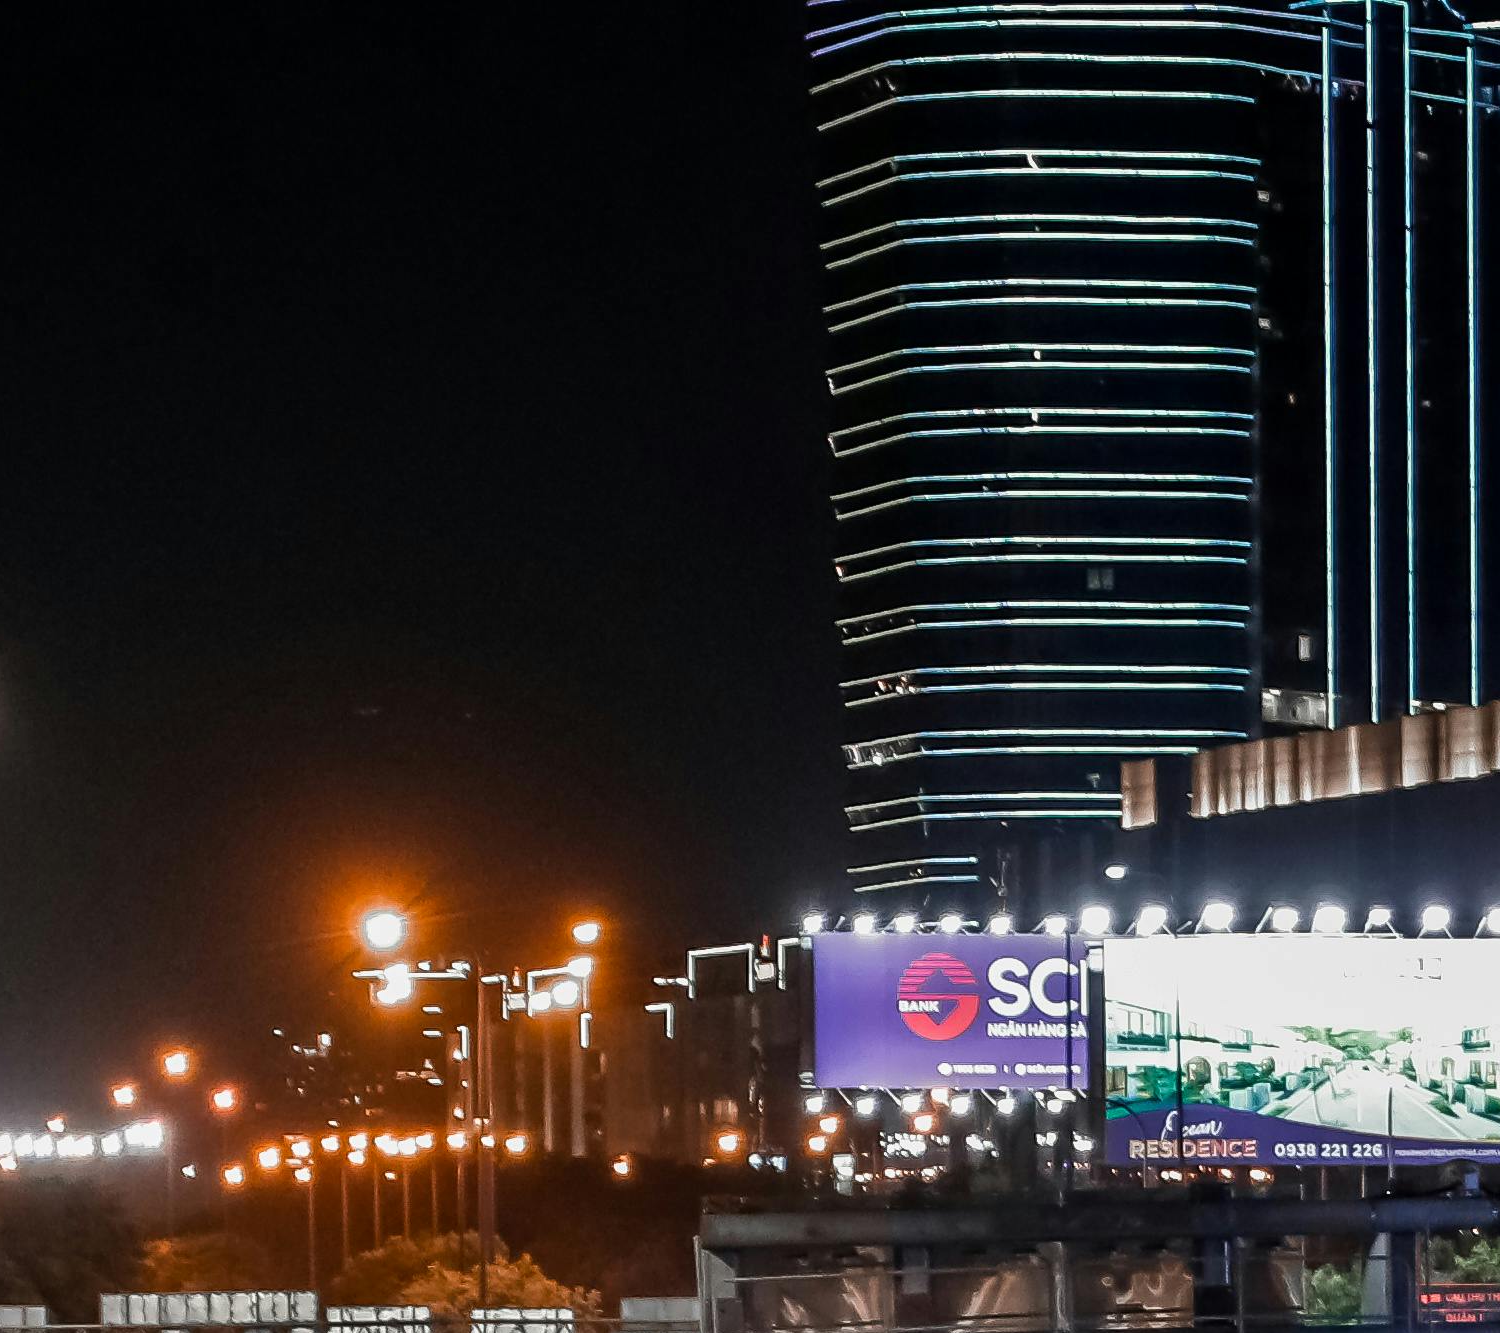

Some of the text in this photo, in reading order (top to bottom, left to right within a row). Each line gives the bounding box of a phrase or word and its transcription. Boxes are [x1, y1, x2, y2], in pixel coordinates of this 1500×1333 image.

[987, 957, 1089, 1017] SC
[899, 1000, 940, 1013] BANK
[987, 1020, 1087, 1037] NGÂN HÀNG SÀ
[1129, 1140, 1257, 1158] RESIDENCE
[1274, 1143, 1382, 1157] 0938 221 226
